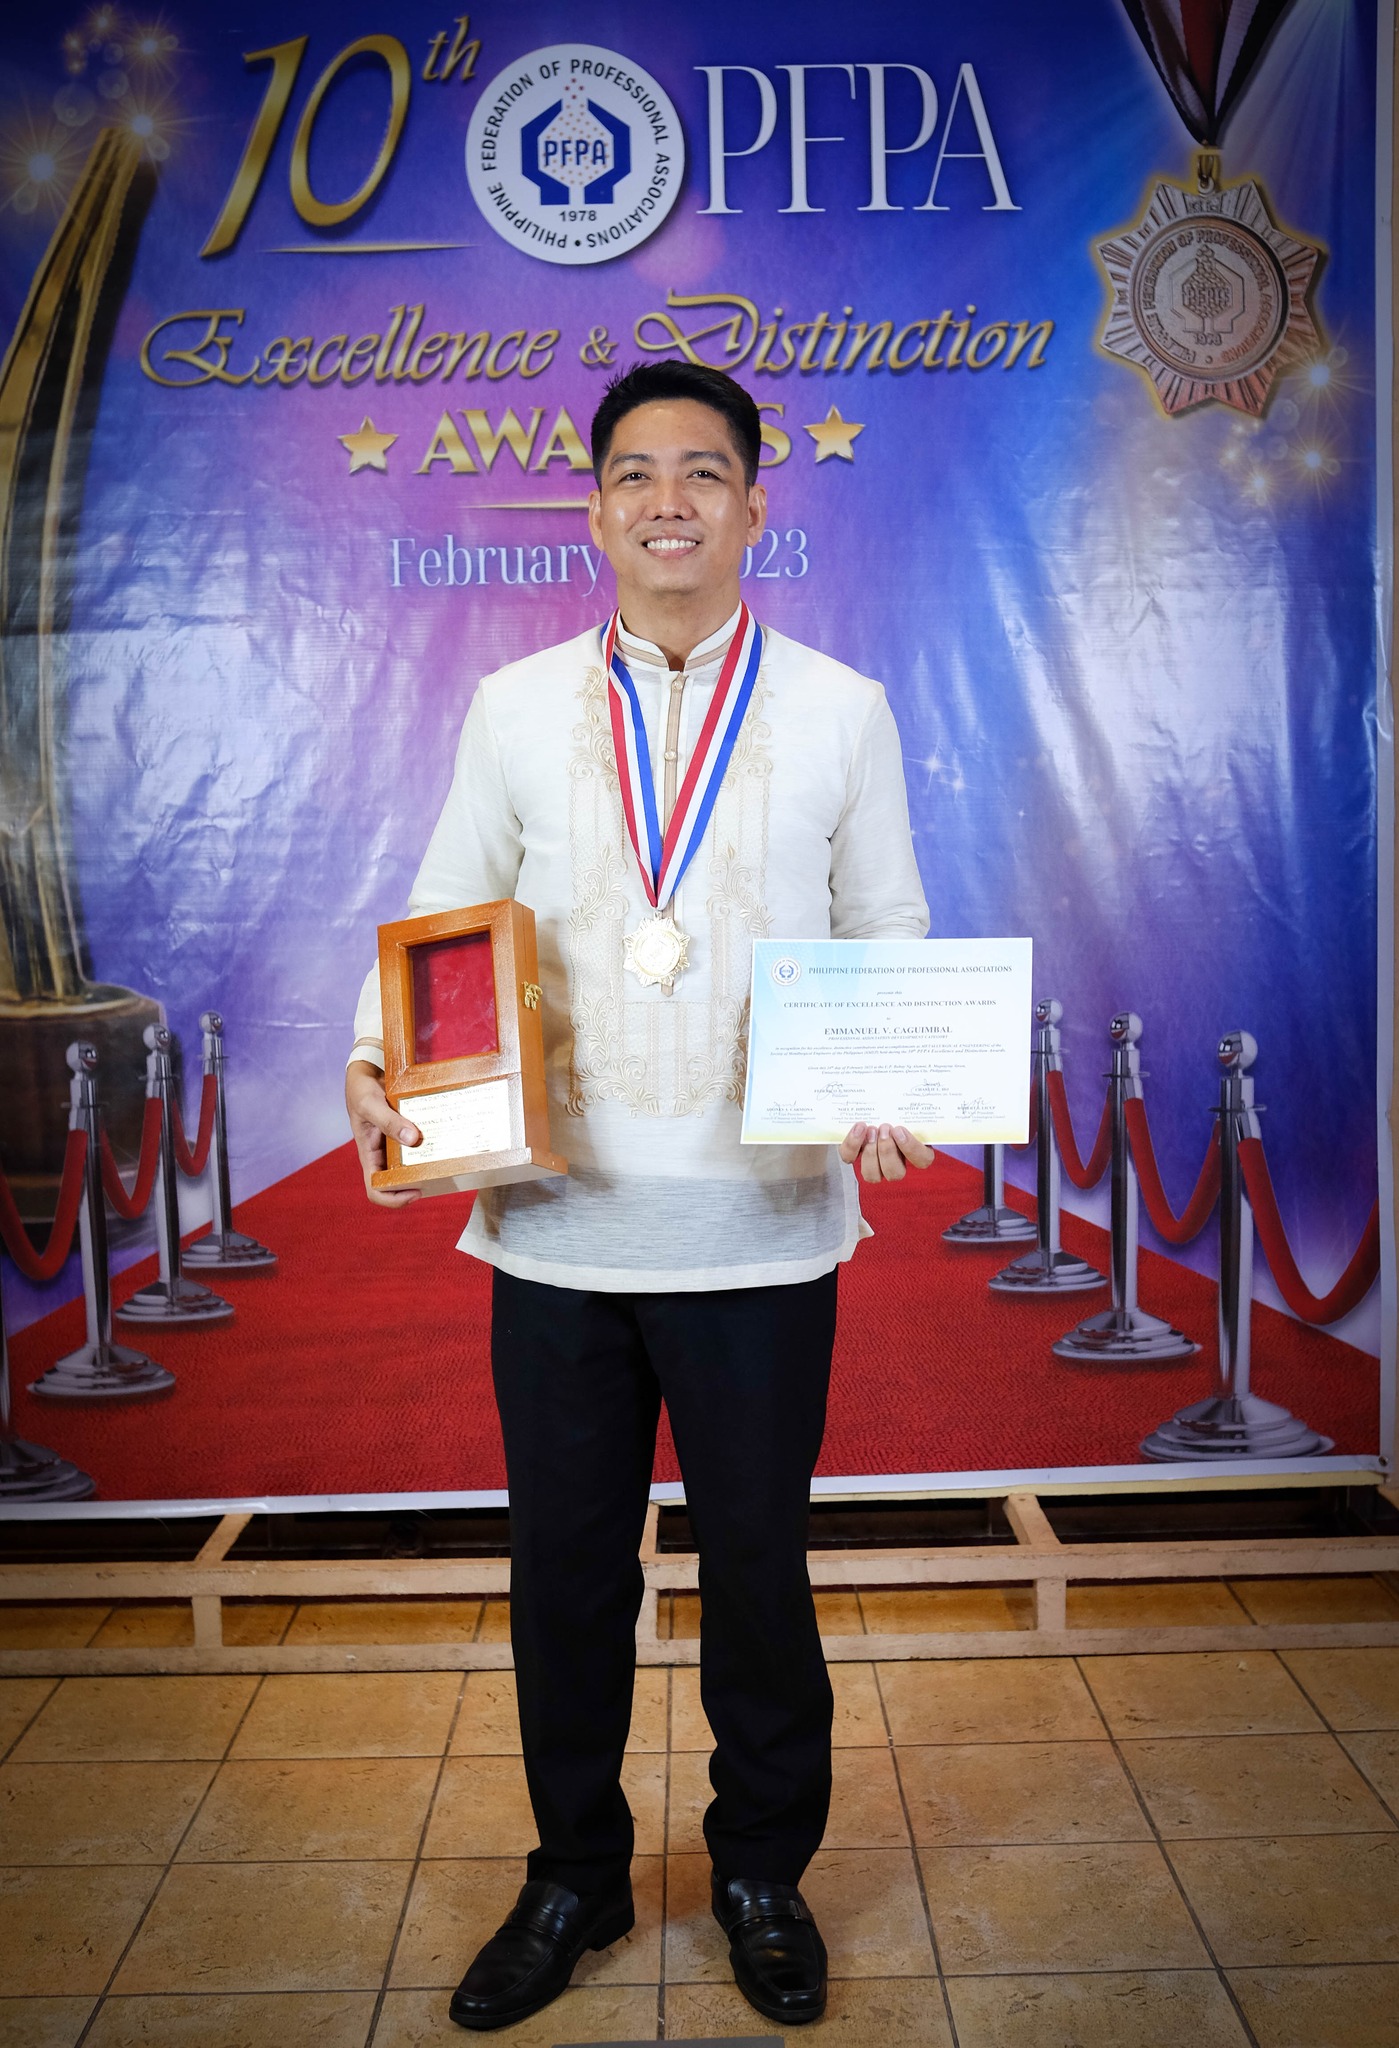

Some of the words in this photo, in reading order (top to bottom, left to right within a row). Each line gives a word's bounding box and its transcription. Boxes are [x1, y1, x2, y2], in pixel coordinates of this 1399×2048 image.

[539, 60, 561, 80] OF
[570, 59, 669, 145] PROFESSIONAL
[481, 73, 534, 172] FEDERATION
[544, 139, 607, 166] PFPA
[693, 62, 1023, 214] PFPA
[487, 181, 568, 248] PHILIPPINE
[559, 210, 597, 222] 1978
[586, 152, 671, 248] ASSOCIATIONS
[140, 302, 560, 388] Excellence
[579, 325, 617, 366] &
[634, 288, 1055, 374] Distinction
[414, 404, 791, 475] AWAS
[390, 534, 604, 598] February
[808, 967, 849, 976] PHILIPPINE
[850, 967, 895, 975] FEDERATION
[896, 966, 906, 974] OF
[907, 966, 960, 974] PROFESSIONAL
[960, 965, 1013, 973] ASSOCIATIONS
[824, 1027, 880, 1035] EMMANUEL
[893, 1026, 953, 1034] CAGUIMBAL
